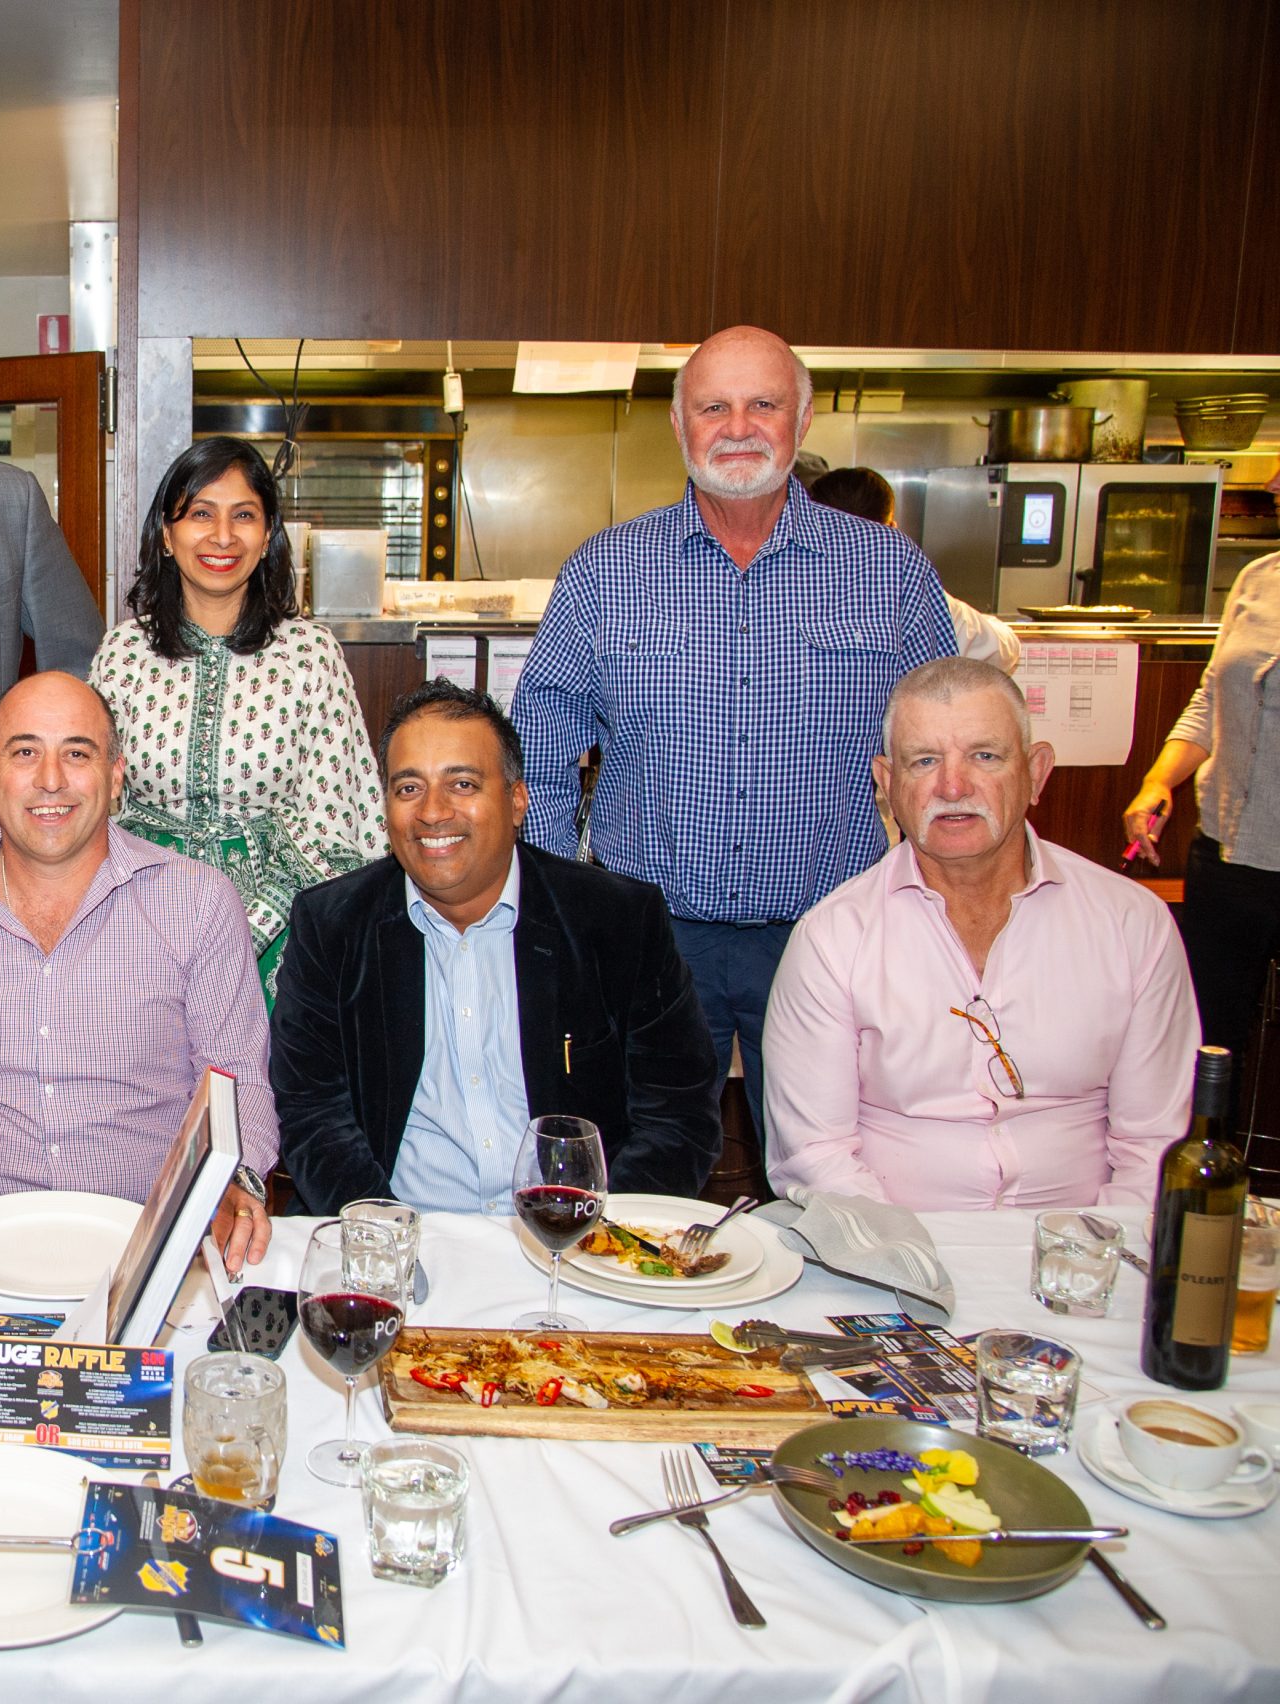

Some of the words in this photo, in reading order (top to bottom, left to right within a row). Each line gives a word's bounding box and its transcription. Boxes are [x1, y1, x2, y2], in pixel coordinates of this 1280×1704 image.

[44, 1347, 126, 1372] RAFFLE
[832, 1401, 899, 1415] AFFLE
[36, 1423, 60, 1445] OR
[211, 1546, 285, 1588] 5
